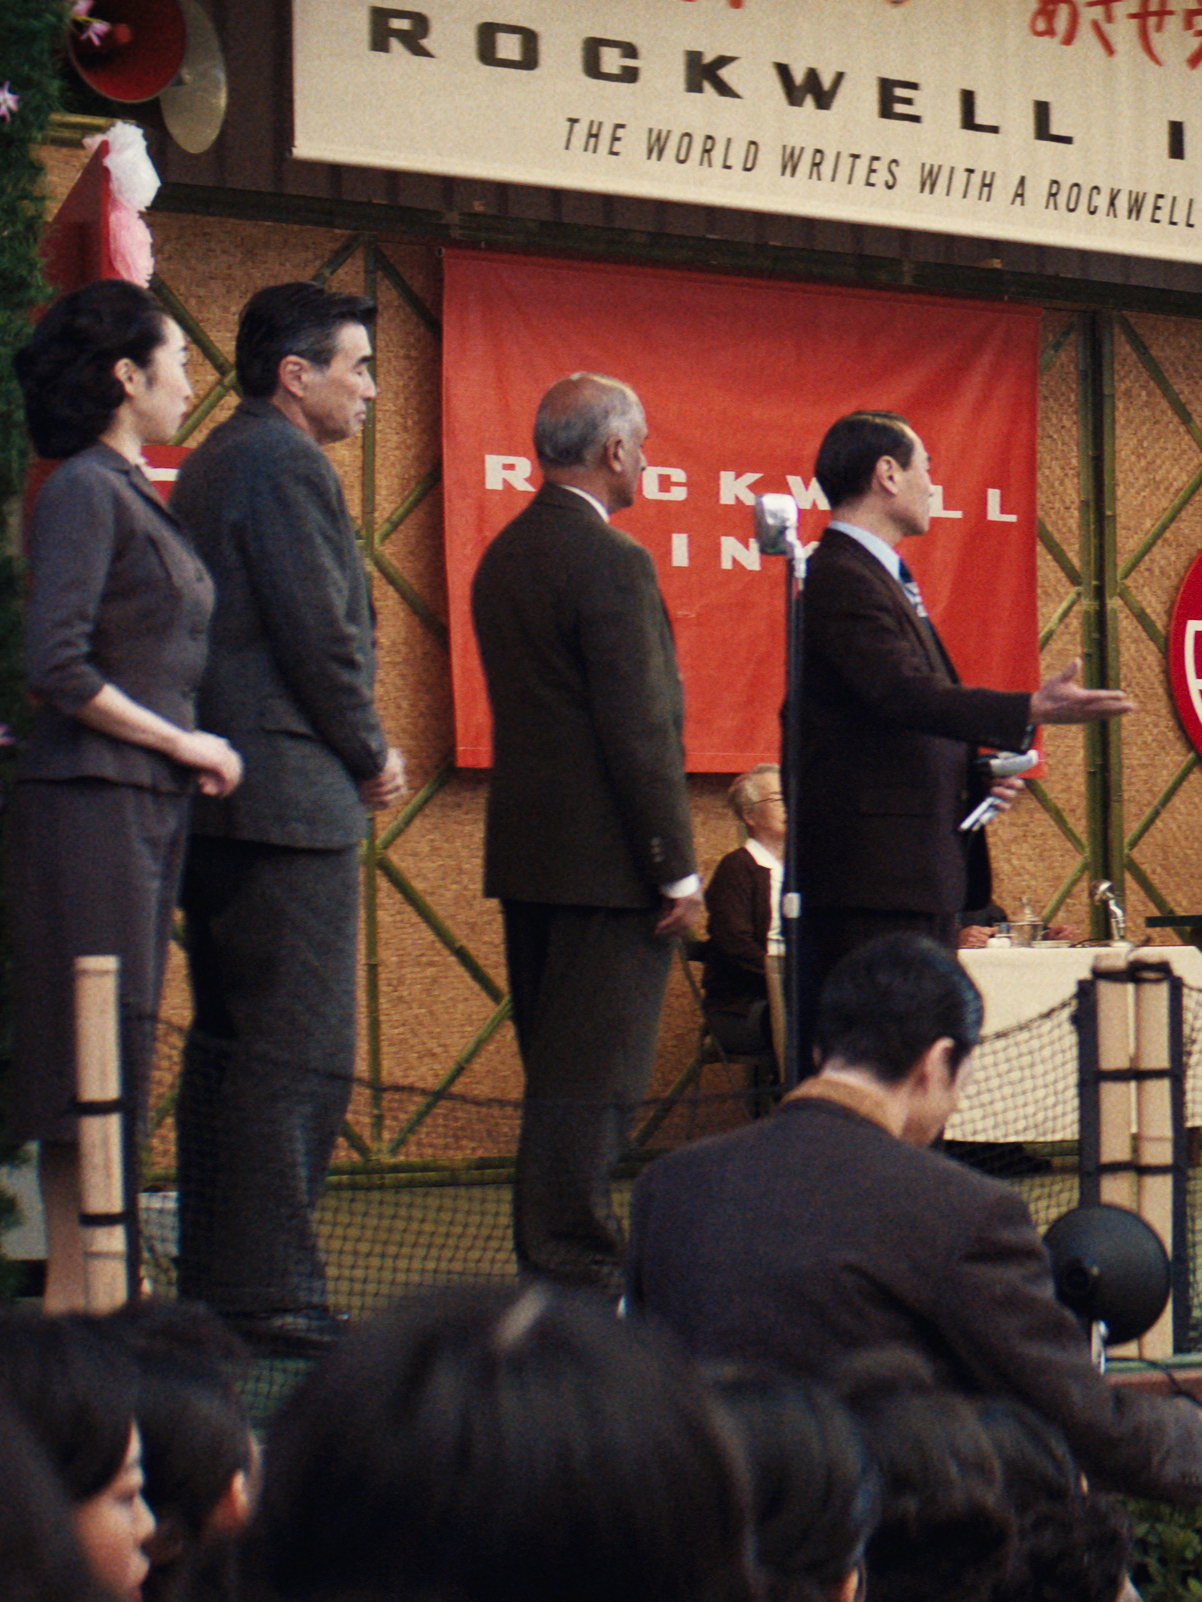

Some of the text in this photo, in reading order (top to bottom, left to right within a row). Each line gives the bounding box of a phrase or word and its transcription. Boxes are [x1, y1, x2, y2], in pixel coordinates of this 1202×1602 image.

[368, 5, 1074, 146] ROCKWELL
[564, 117, 1197, 228] THE WORLD WRITES WITH A ROCKWELL
[484, 453, 1018, 522] RCKWLL
